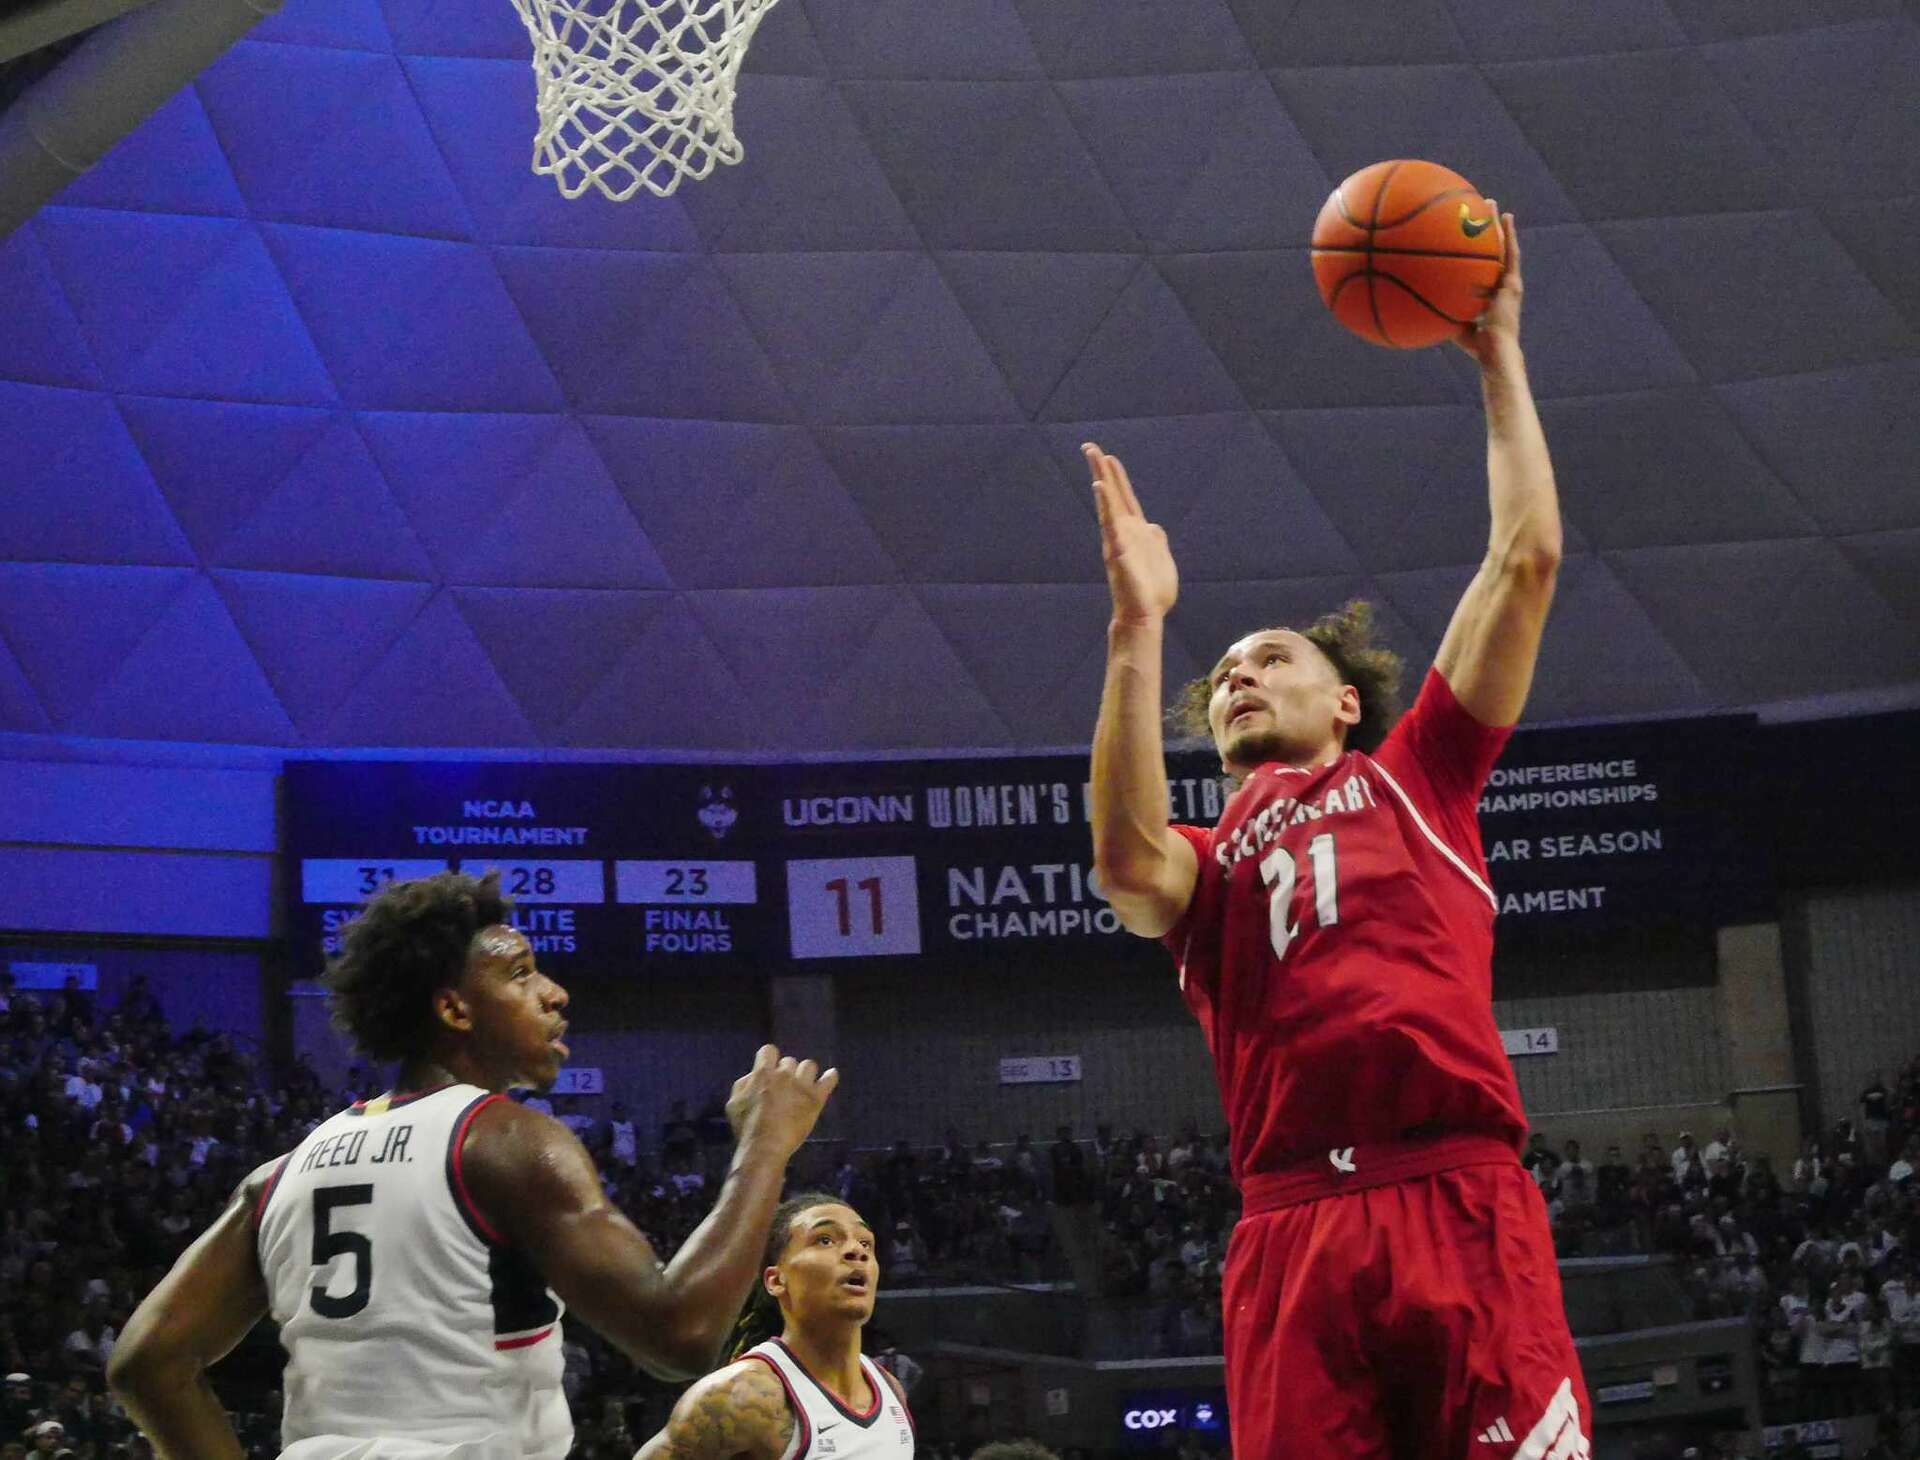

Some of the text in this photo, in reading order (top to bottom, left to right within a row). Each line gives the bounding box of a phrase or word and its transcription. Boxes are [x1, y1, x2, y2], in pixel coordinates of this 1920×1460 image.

[1484, 760, 1637, 787] ONFERENCE
[463, 800, 536, 819] NCAA
[783, 795, 914, 827] UCONN
[926, 782, 1071, 829] WOMEN'S
[1476, 784, 1659, 813] HAMPIONSHIPS
[413, 826, 590, 847] TOURNAMENT
[1484, 829, 1663, 863] AR SEASON
[511, 867, 555, 895] 28
[664, 867, 709, 896] 23
[825, 876, 884, 937] 11
[1259, 833, 1339, 961] 21
[1497, 886, 1606, 914] AMENT
[510, 909, 577, 931] LITE
[645, 910, 731, 932] FINAL
[948, 908, 1121, 941] CHAMPIO
[646, 934, 732, 953] FOURS
[1525, 1033, 1550, 1049] 14
[569, 1072, 594, 1090] 12
[1049, 1060, 1073, 1077] 13
[300, 1125, 414, 1173] REED JR.
[309, 1183, 374, 1319] 5
[1124, 1408, 1178, 1430] COX
